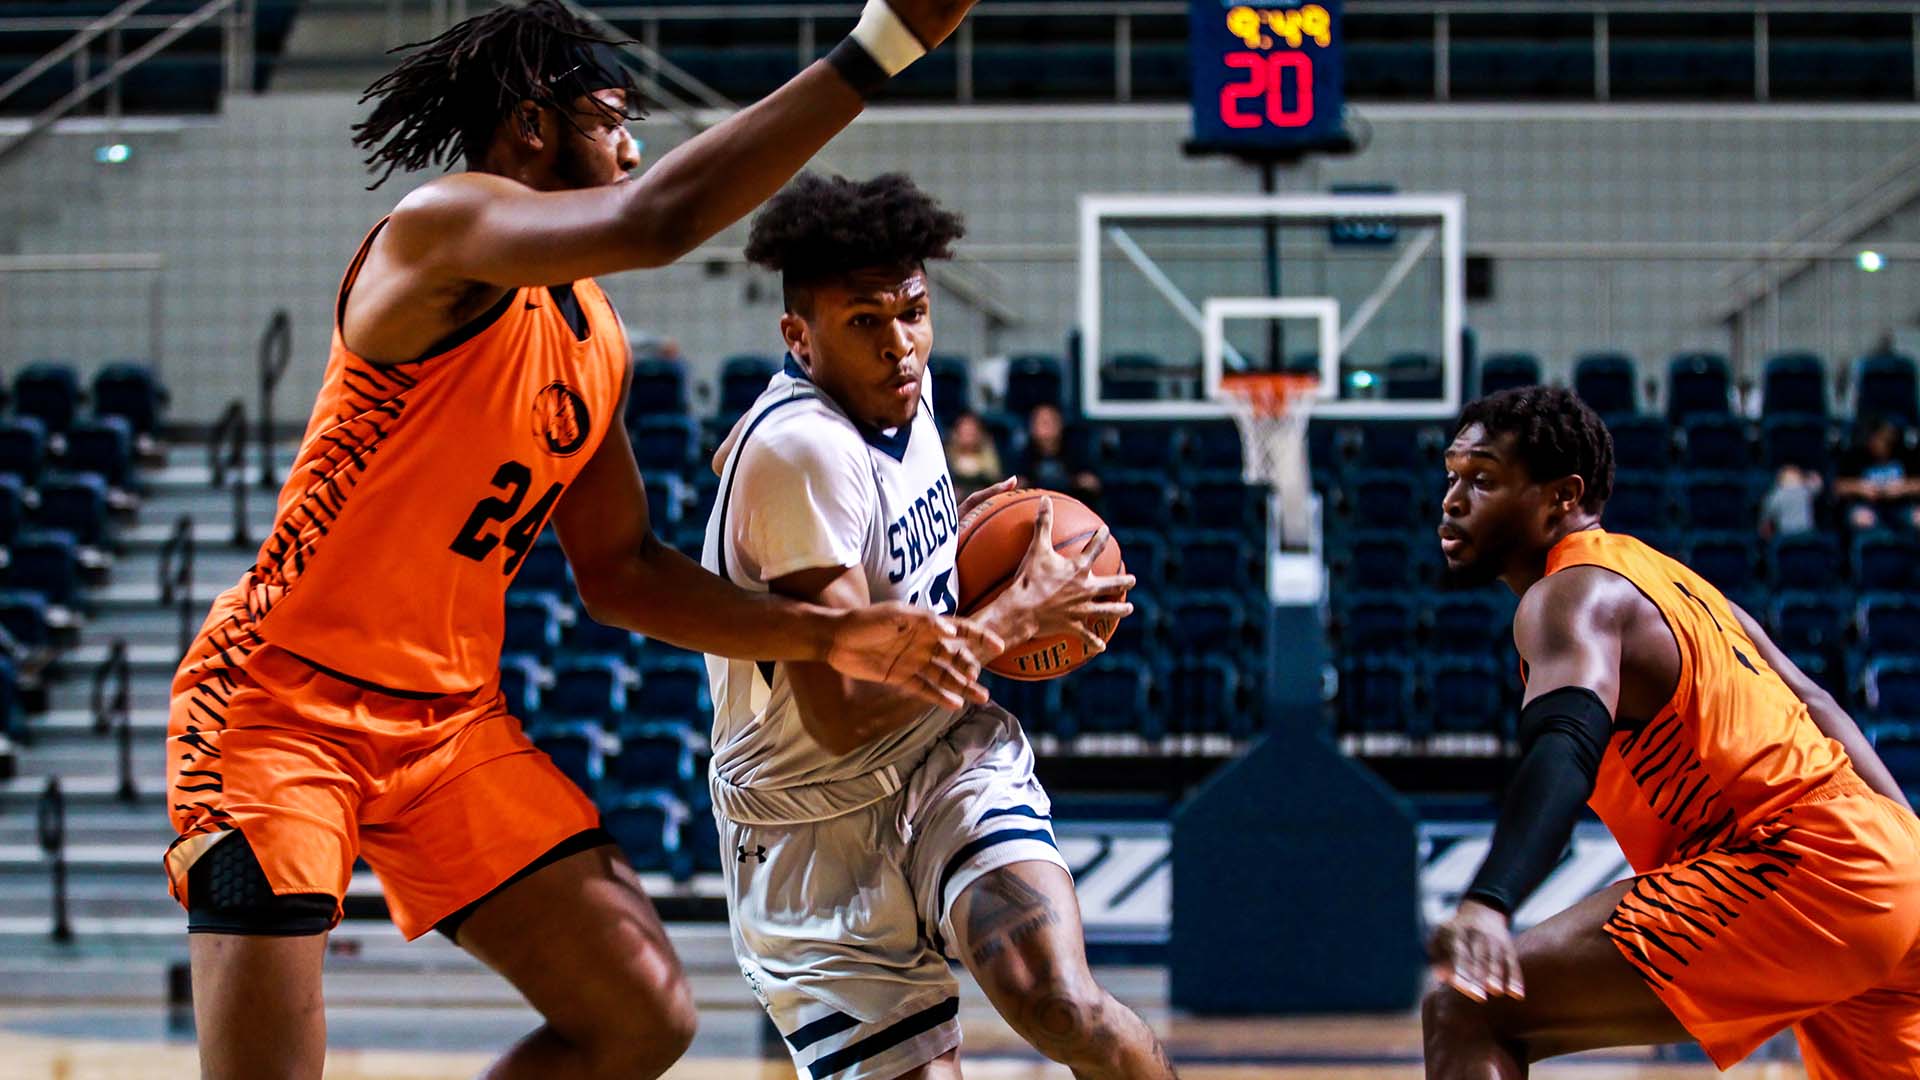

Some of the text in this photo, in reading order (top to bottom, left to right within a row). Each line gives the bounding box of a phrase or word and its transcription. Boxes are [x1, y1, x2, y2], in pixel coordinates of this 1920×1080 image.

[1226, 4, 1332, 49] 9:49
[1220, 50, 1314, 129] 20
[448, 460, 564, 576] 24
[887, 473, 958, 585] SWOSU
[1013, 639, 1071, 672] THE
